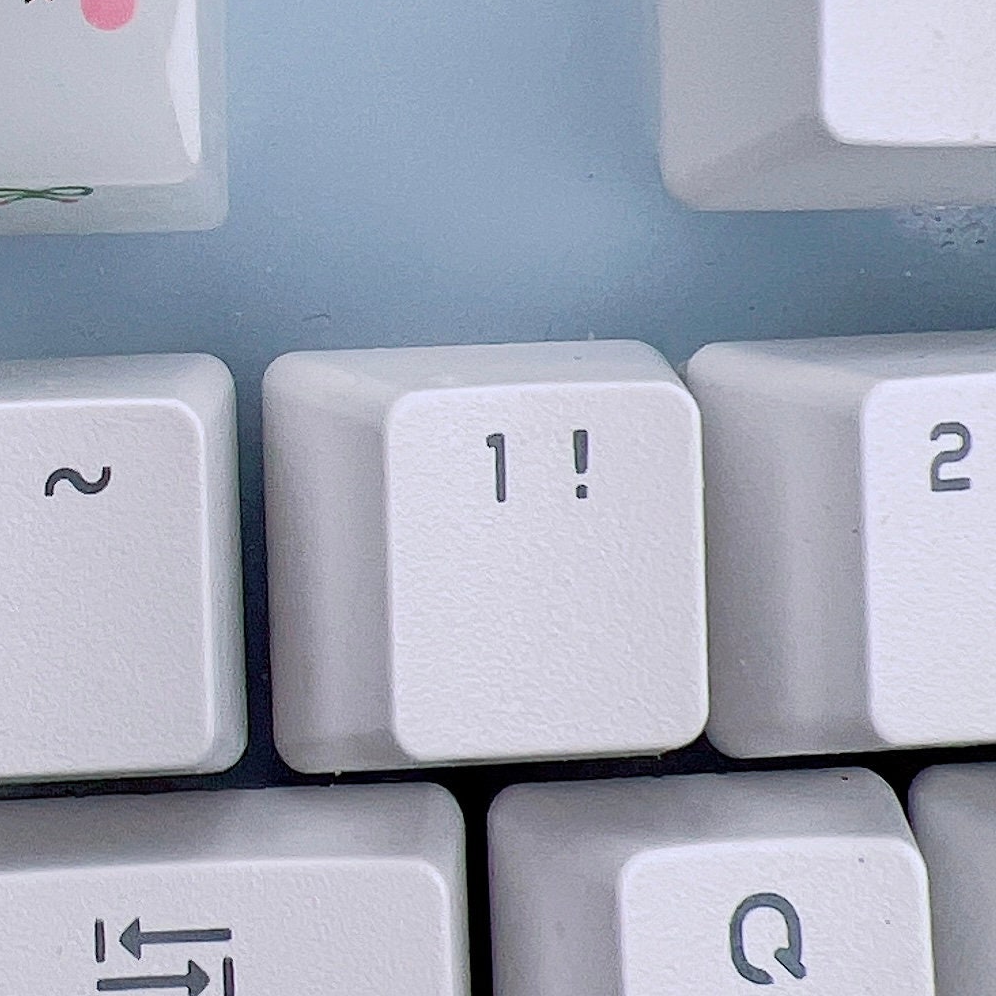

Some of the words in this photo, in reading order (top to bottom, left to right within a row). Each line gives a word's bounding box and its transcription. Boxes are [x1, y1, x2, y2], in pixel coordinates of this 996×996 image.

[43, 465, 112, 497] ~
[485, 432, 507, 503] 1
[572, 428, 589, 500] !
[929, 421, 972, 493] 2
[728, 892, 807, 985] Q
